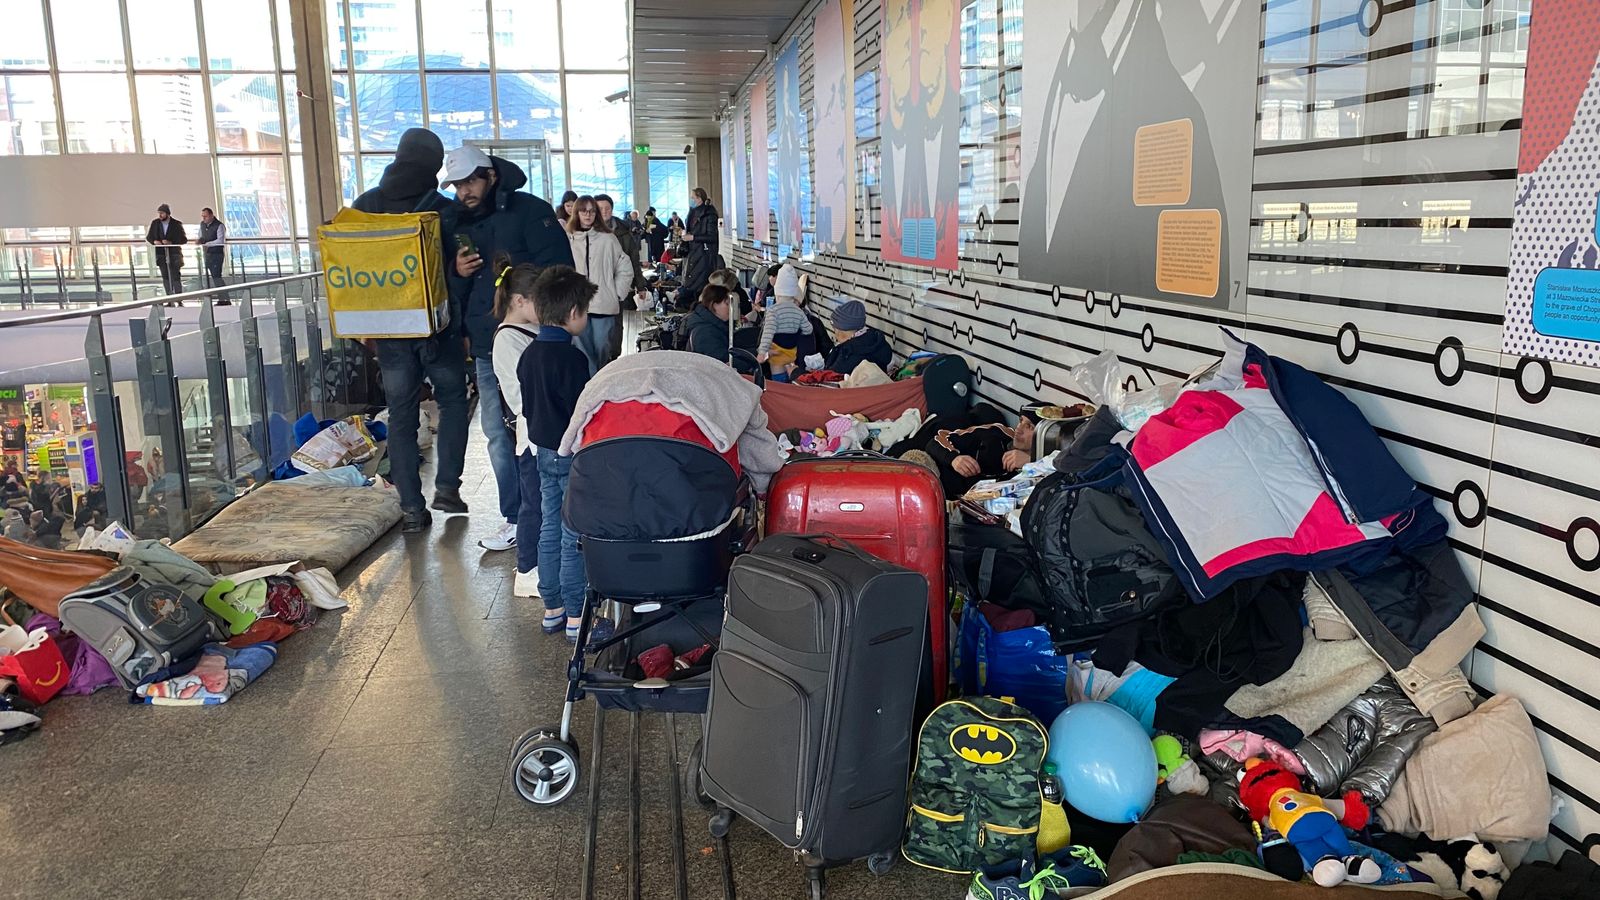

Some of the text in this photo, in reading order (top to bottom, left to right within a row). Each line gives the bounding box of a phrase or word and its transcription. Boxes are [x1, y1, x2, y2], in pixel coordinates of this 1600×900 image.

[327, 265, 408, 289] Glovo
[1233, 280, 1241, 298] 7
[1544, 311, 1561, 319] people
